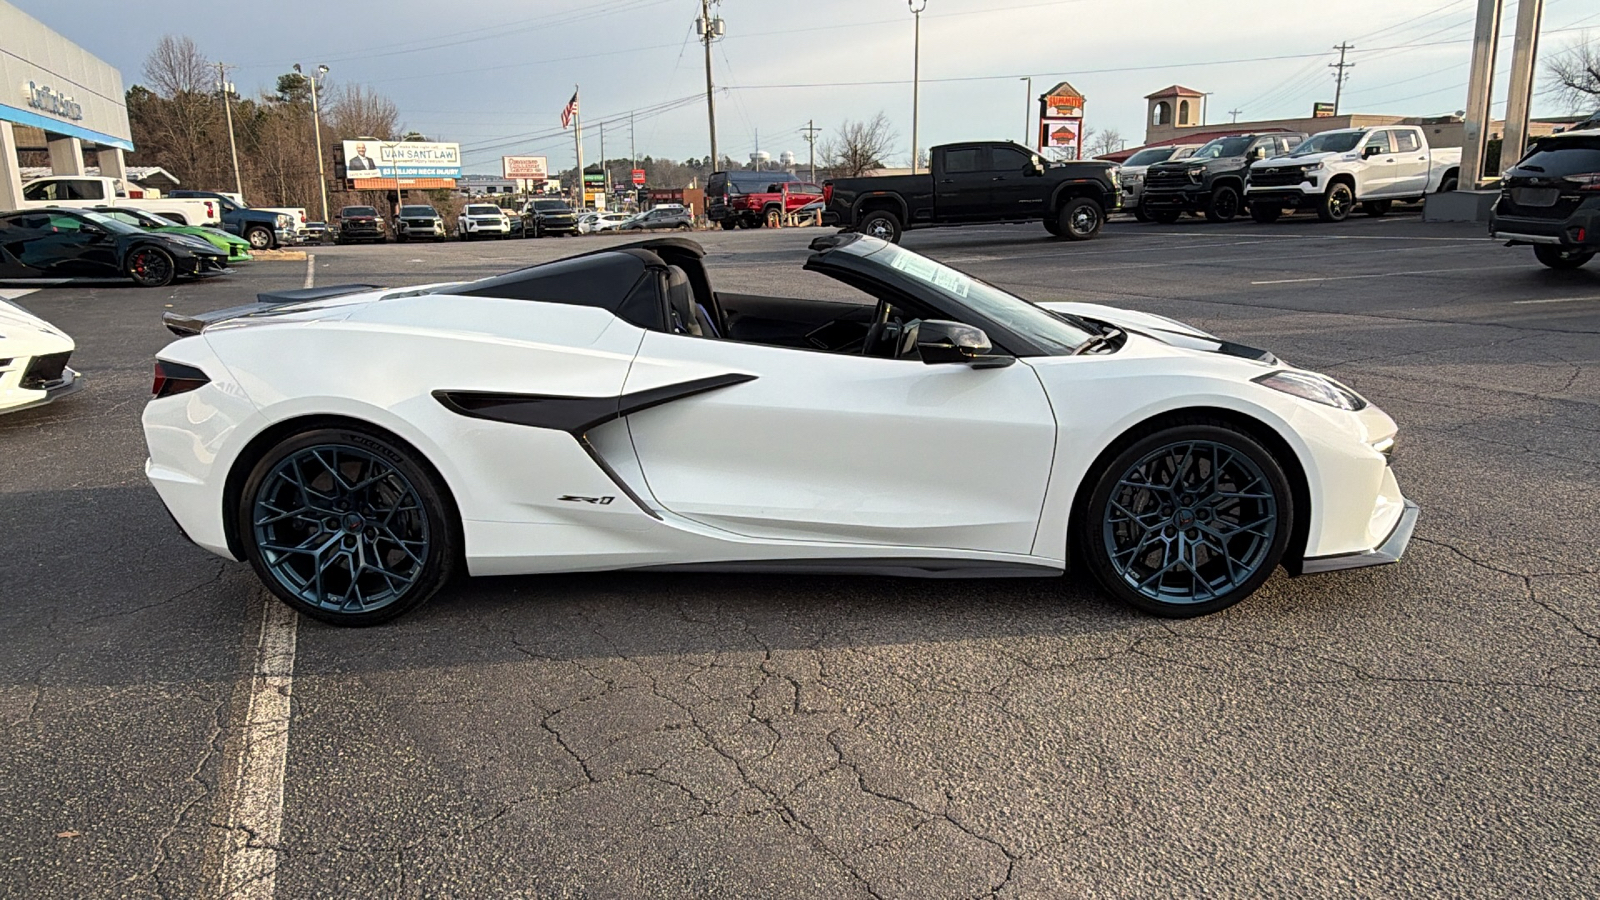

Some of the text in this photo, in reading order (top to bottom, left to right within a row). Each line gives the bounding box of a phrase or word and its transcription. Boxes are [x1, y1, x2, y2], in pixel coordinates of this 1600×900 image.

[384, 149, 454, 159] VAN SANT LAW
[353, 436, 401, 463] MICHELIN
